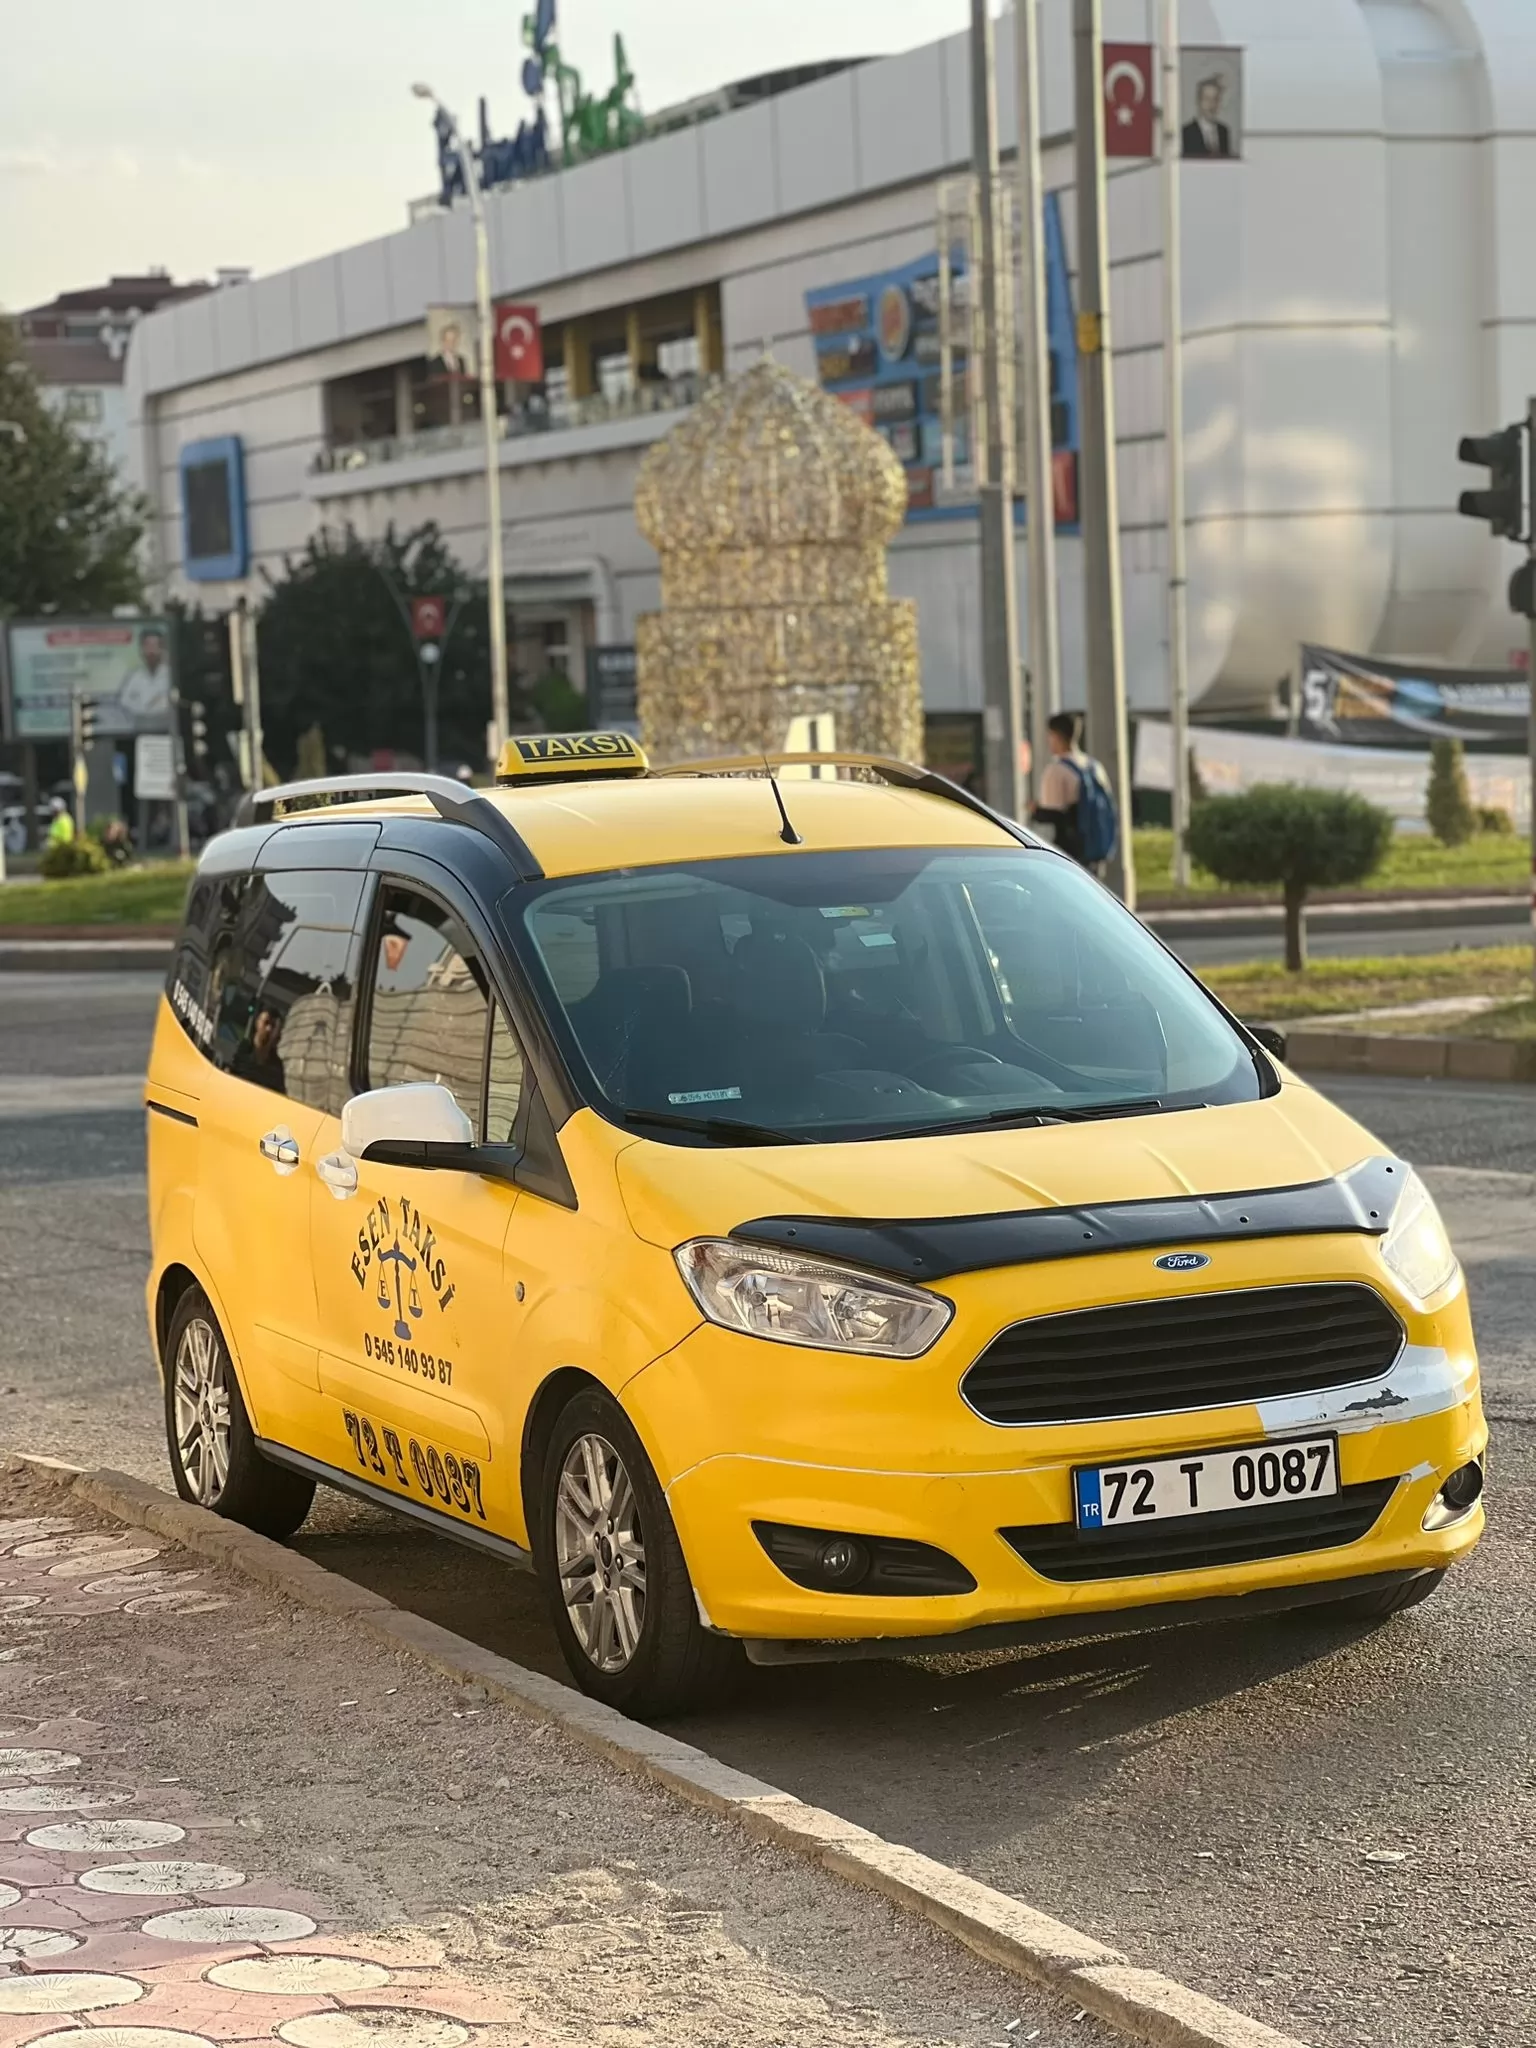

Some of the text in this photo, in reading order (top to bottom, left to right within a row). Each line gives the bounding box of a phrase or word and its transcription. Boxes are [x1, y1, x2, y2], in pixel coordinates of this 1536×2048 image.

[351, 1196, 391, 1291] ESEN
[1167, 1255, 1199, 1268] Ford
[379, 1279, 418, 1307] E T
[364, 1332, 453, 1386] 0 545 140 93 87
[381, 1426, 410, 1487] T
[409, 1438, 487, 1521] 0087
[1104, 1445, 1330, 1519] 72 T 0087
[1082, 1503, 1099, 1518] TR
